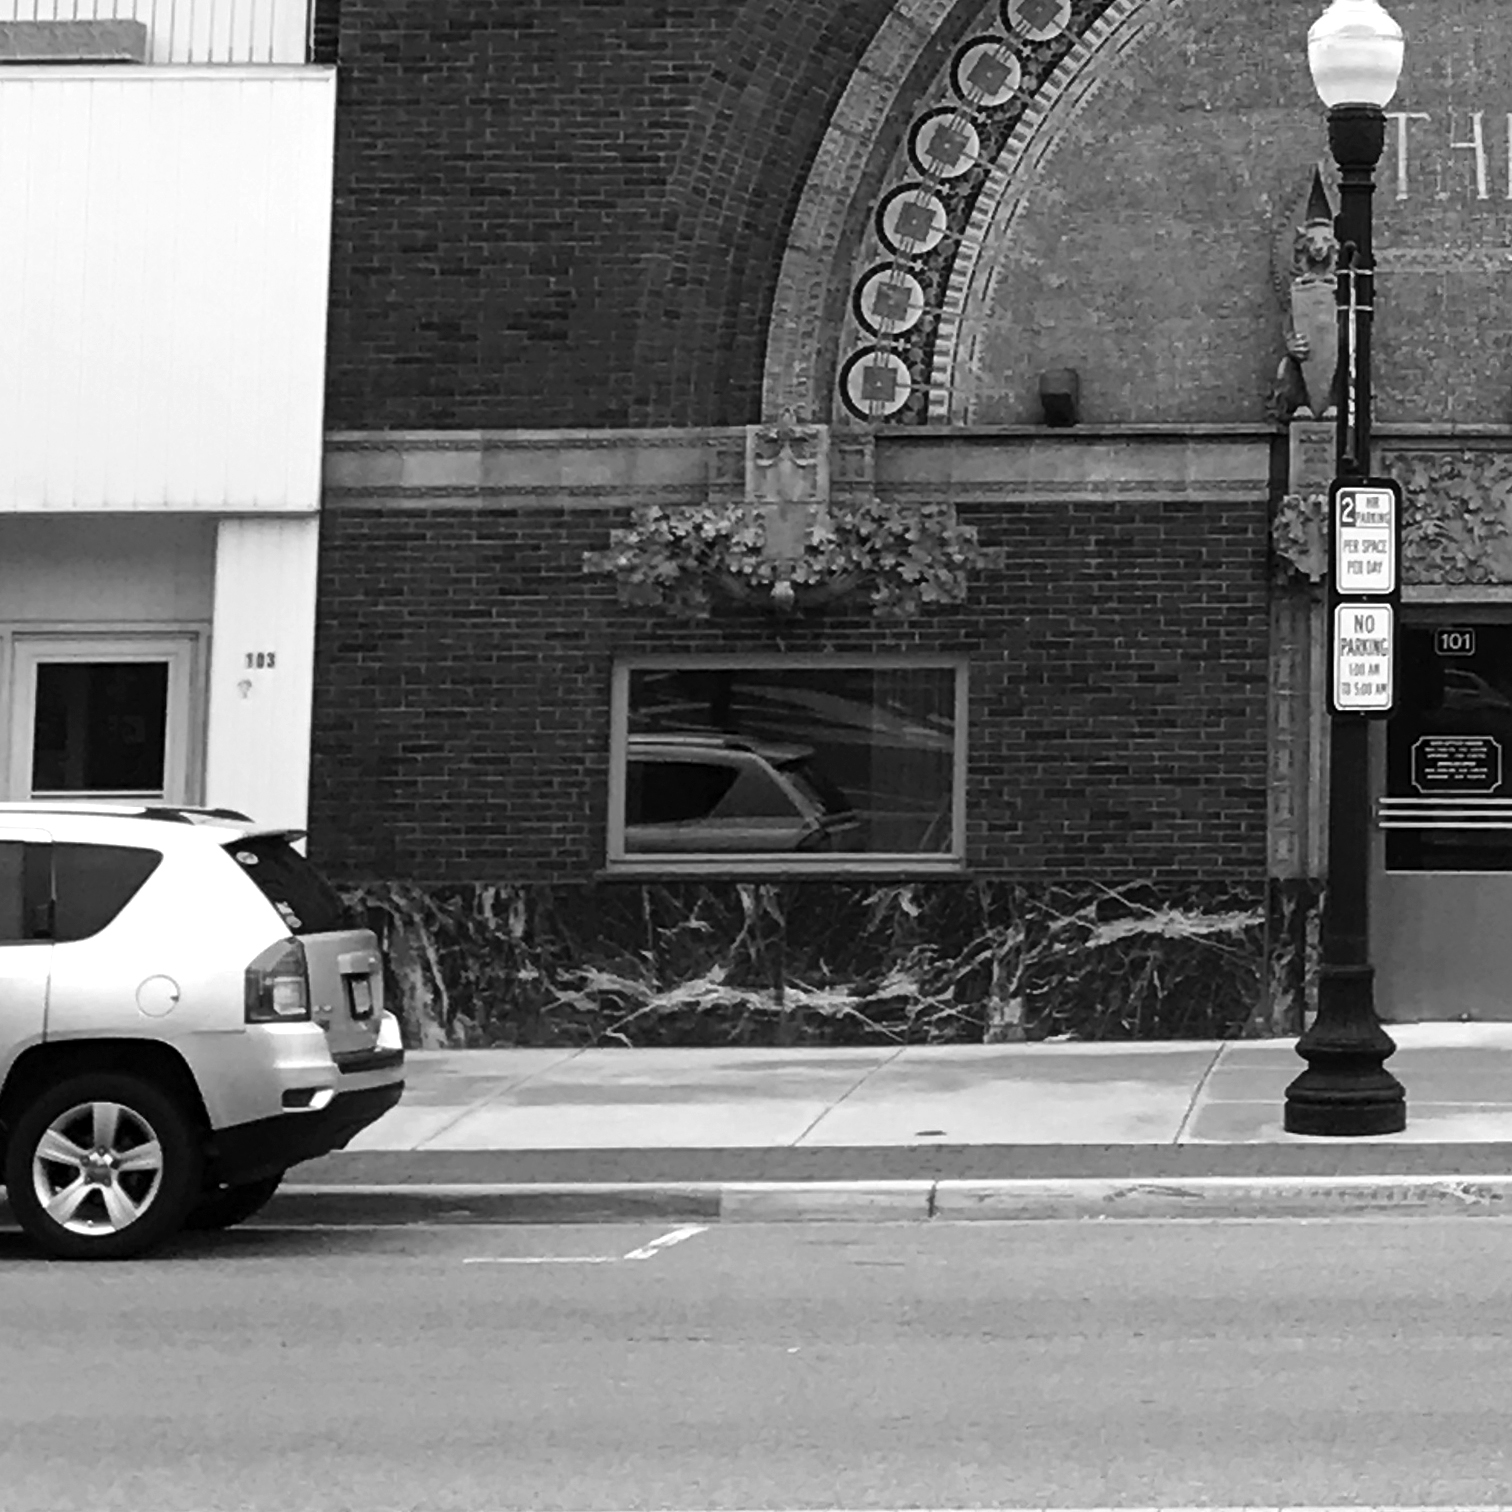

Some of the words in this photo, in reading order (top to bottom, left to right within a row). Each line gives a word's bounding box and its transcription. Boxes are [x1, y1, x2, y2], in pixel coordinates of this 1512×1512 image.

[1341, 496, 1354, 523] 2
[1343, 539, 1359, 554] PER
[1362, 539, 1387, 554] SPACE
[1366, 560, 1383, 575] DAY
[1354, 614, 1375, 634] NO
[1340, 637, 1388, 657] PARKING
[1440, 633, 1471, 650] 101
[245, 651, 276, 670] 103
